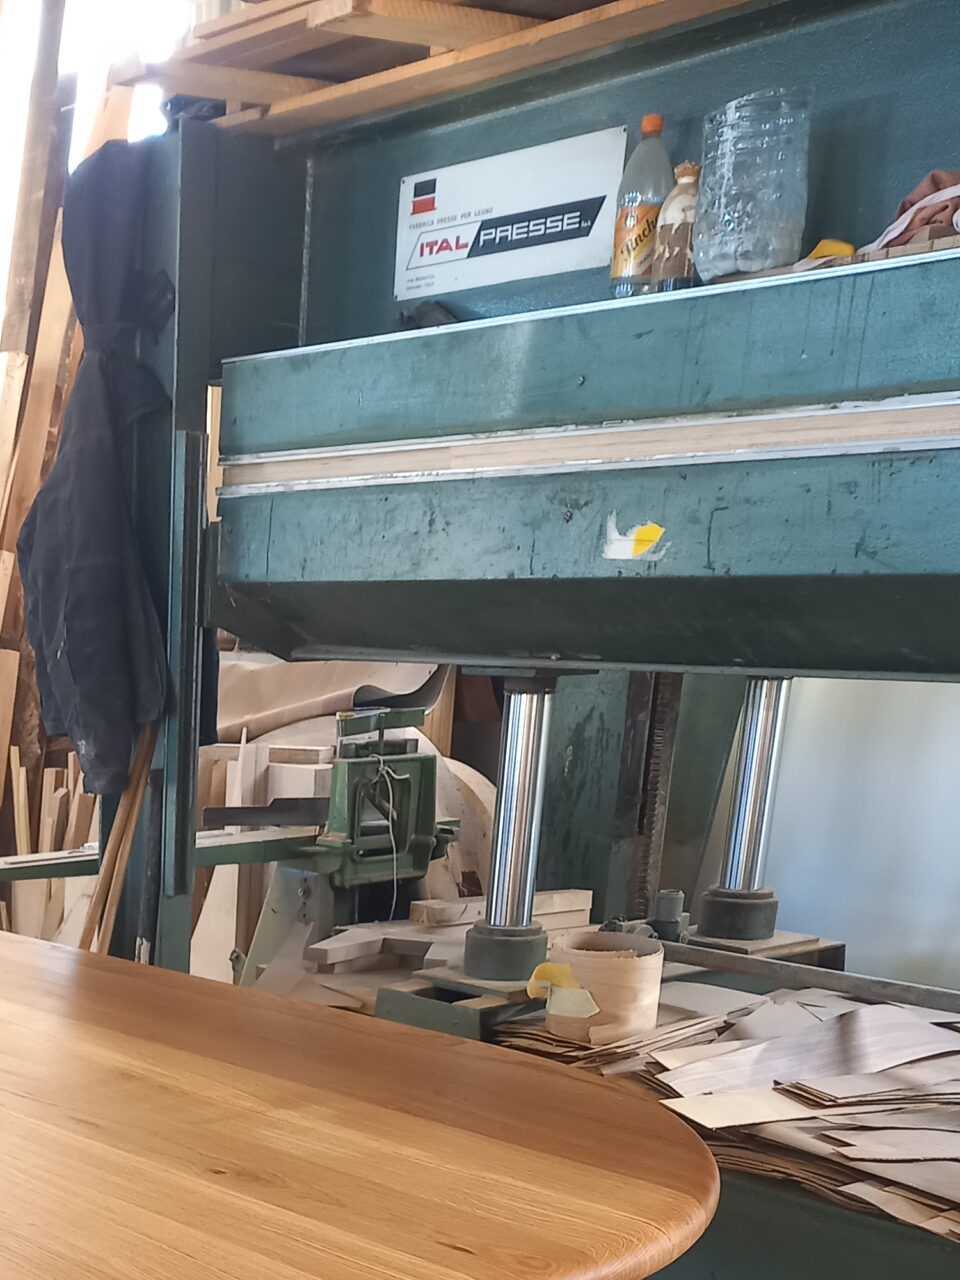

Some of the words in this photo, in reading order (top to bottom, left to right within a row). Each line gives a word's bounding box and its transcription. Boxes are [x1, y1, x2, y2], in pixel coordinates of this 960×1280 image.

[460, 212, 472, 220] PER
[419, 235, 469, 258] ITAL
[479, 211, 581, 248] PRESSE
